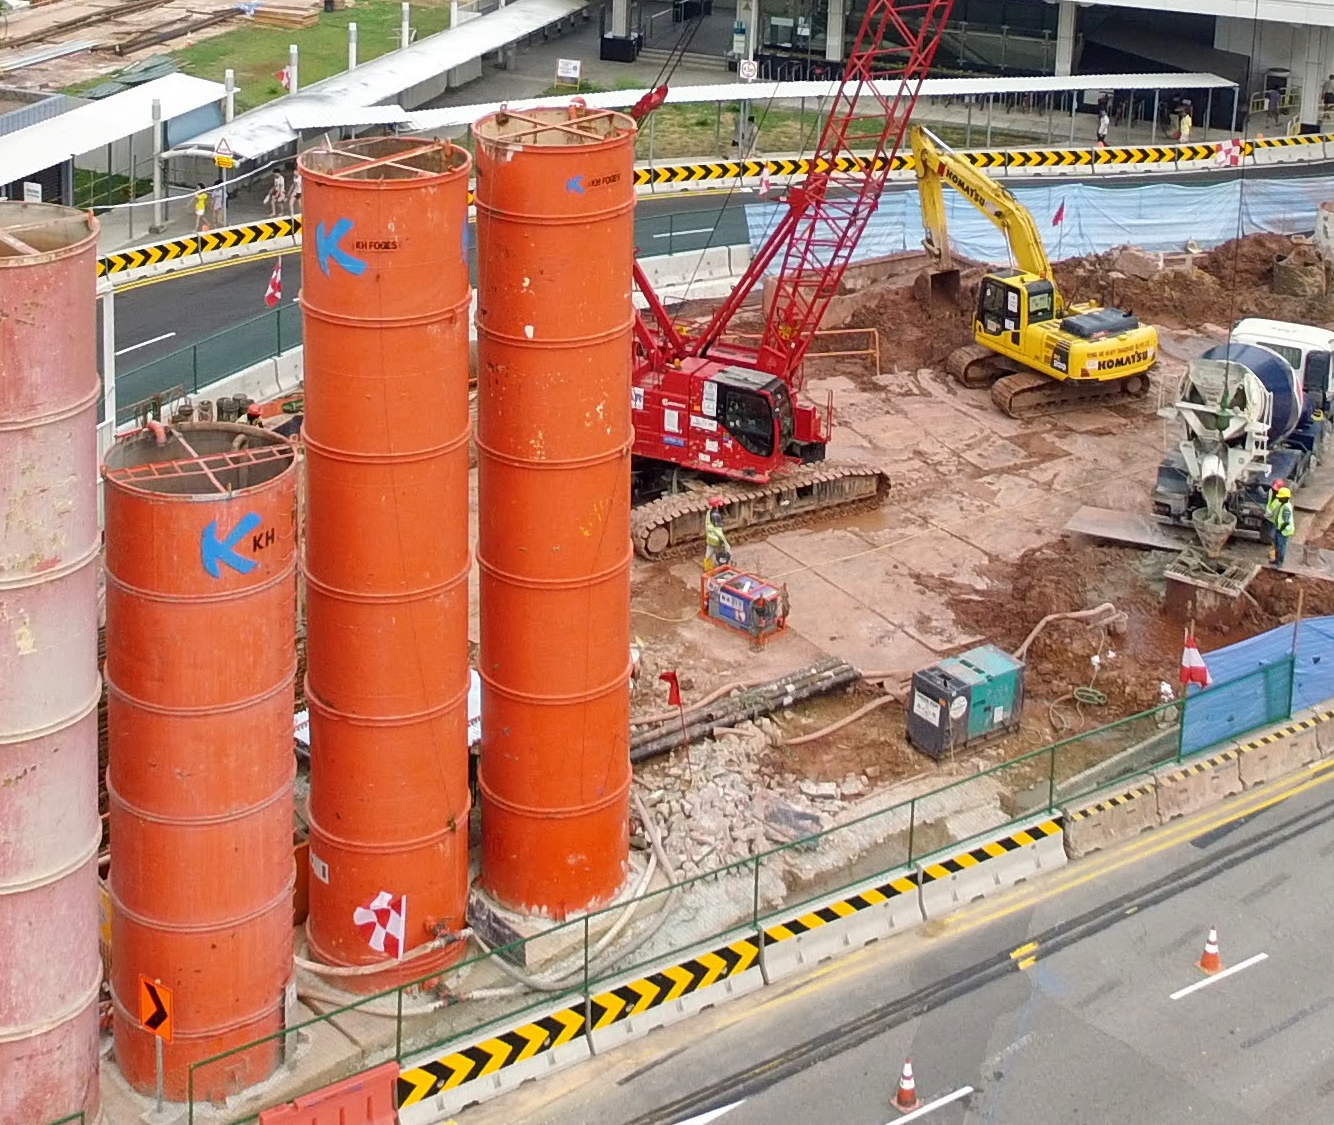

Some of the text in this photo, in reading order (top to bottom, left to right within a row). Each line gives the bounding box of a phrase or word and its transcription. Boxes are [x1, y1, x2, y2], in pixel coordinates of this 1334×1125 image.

[946, 169, 986, 207] KOMATSU
[355, 241, 367, 250] KH
[368, 241, 398, 250] FOGES
[1098, 349, 1149, 371] KOMATSU
[253, 527, 275, 553] KH
